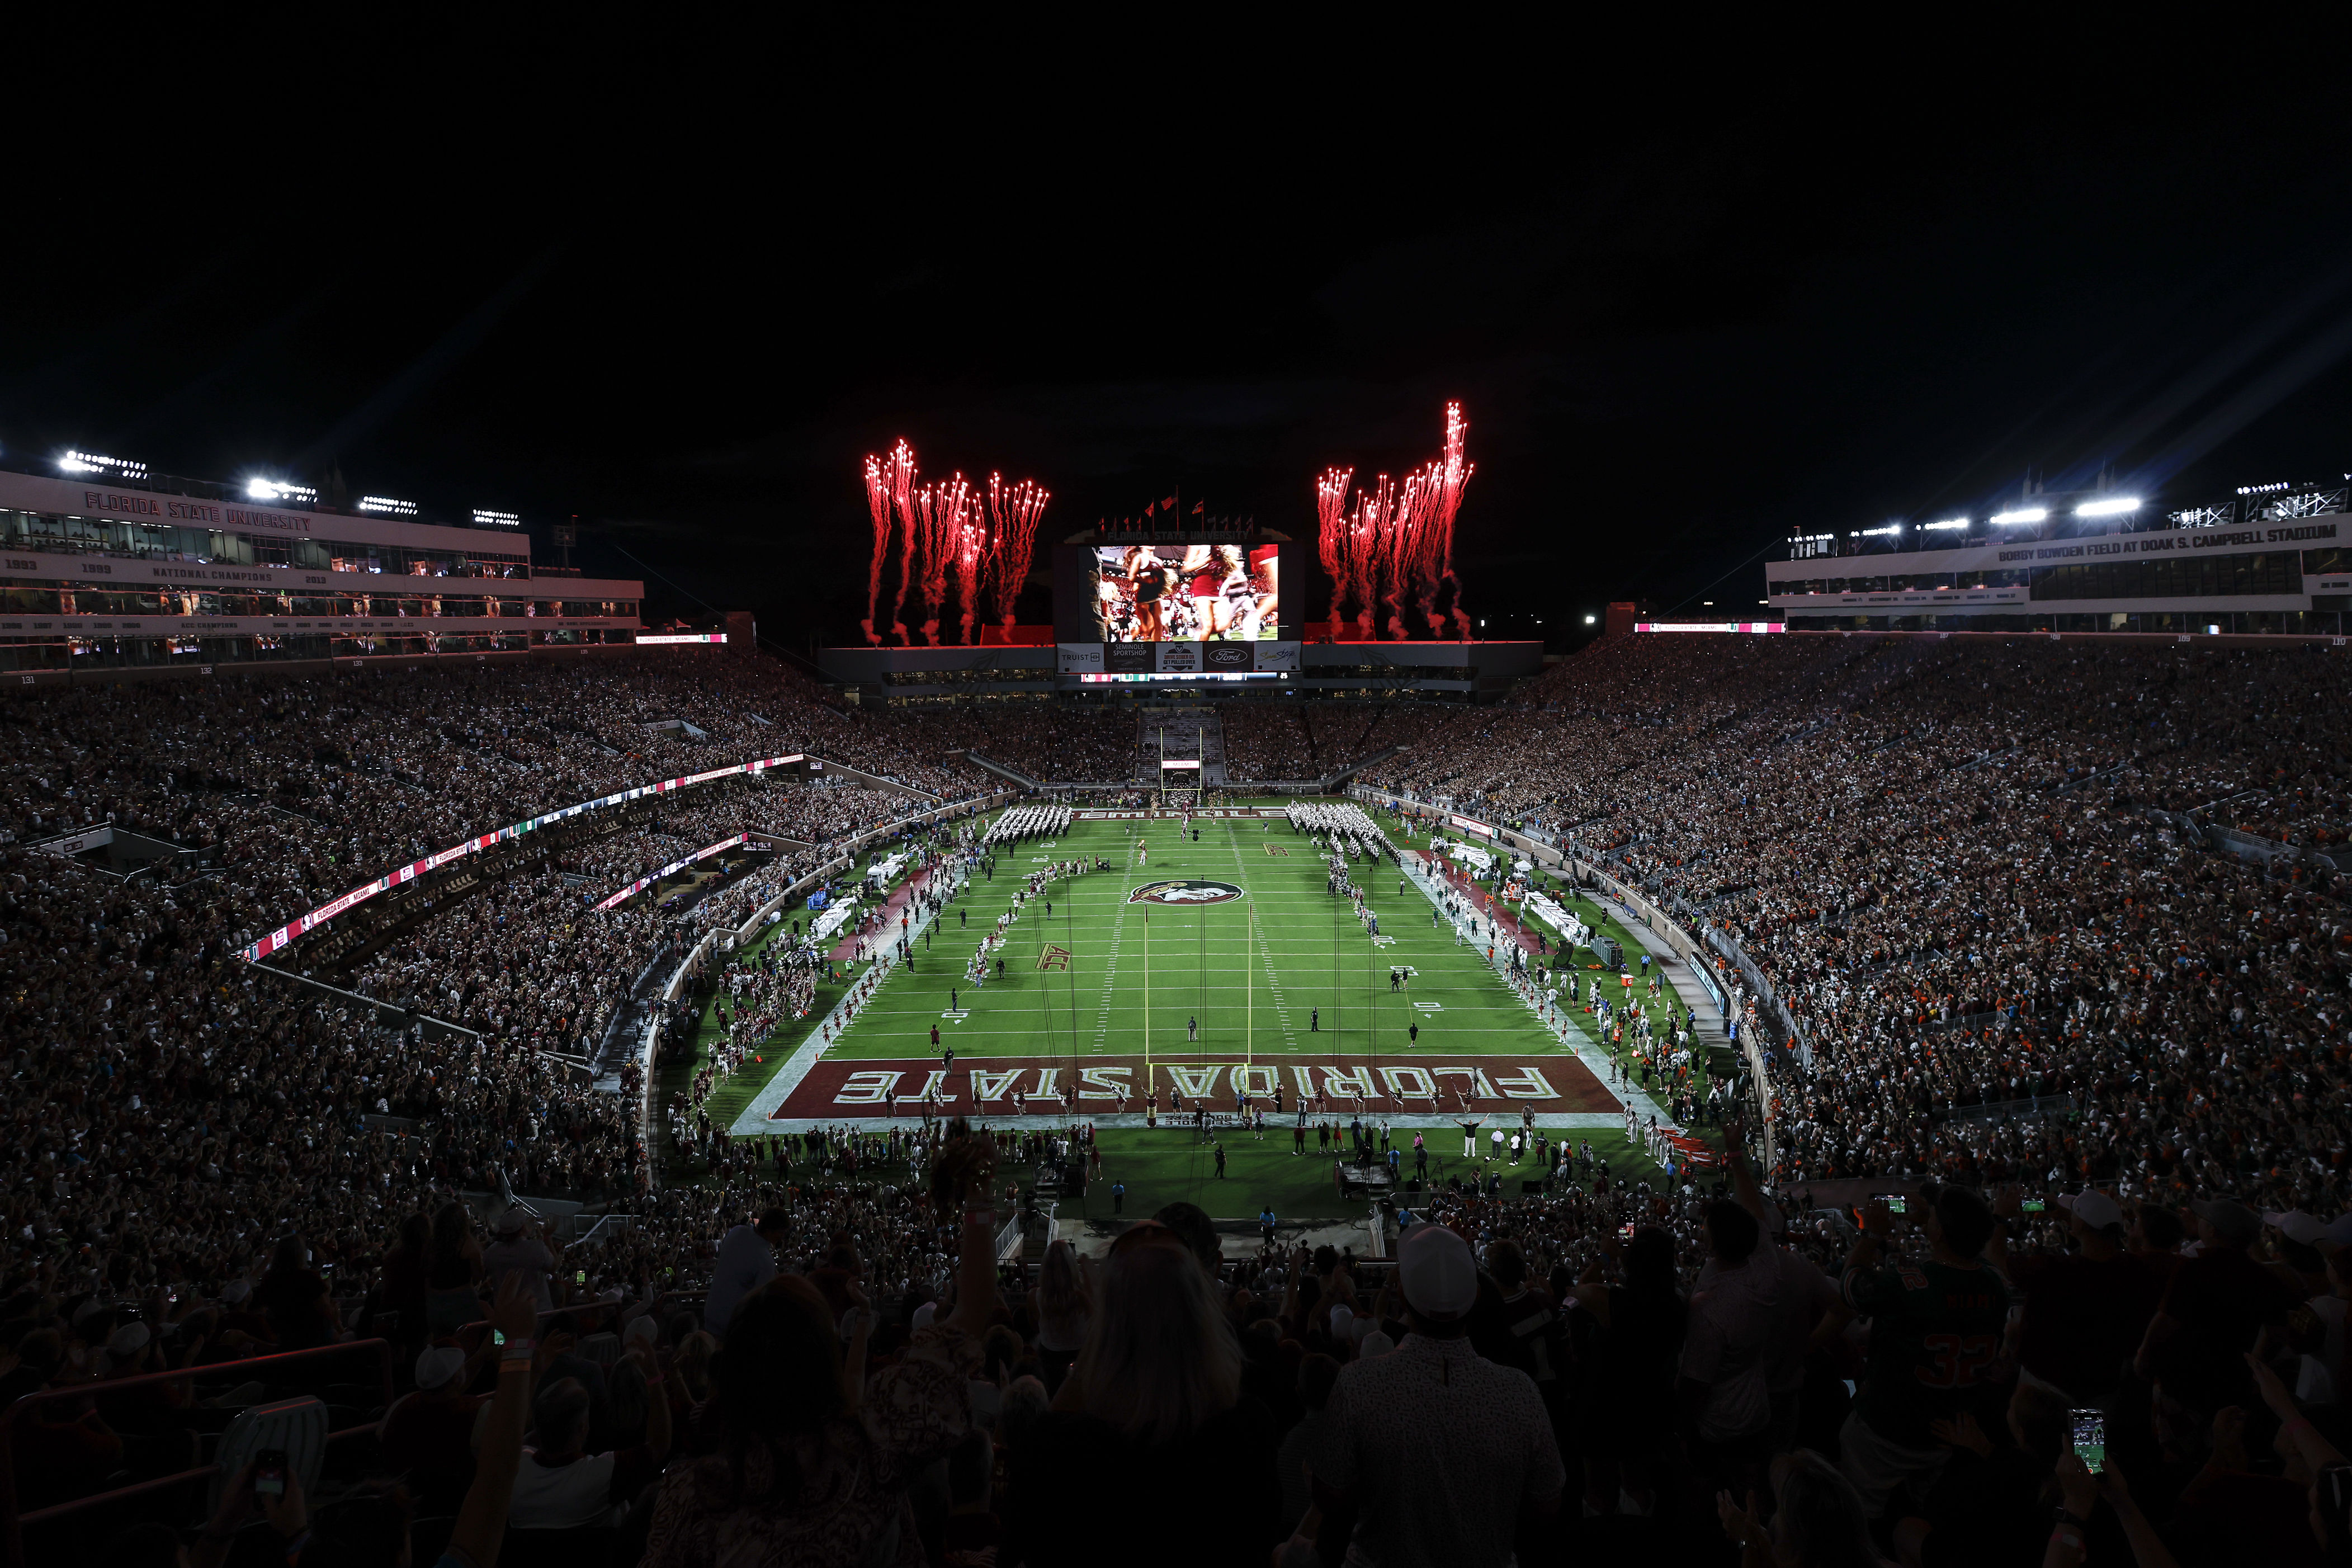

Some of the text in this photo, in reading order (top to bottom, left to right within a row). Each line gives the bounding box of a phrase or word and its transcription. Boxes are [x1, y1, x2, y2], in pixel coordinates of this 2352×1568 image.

[86, 492, 311, 531] FLORIDA STATE UNIVERSITY
[1107, 531, 1249, 541] FLORIDA STATE UNIVERSITY
[1999, 524, 2336, 561] BOBBY BOWDEN FIELD AT DOAK S. CAMPBELL STADIUM
[6, 559, 37, 570] 1993
[82, 564, 111, 574] 1999
[153, 568, 272, 582] NATIONAL CHAMPIONS
[2332, 638, 2346, 646] 110
[1216, 650, 1240, 661] Ford
[22, 676, 35, 684] 131
[574, 805, 583, 815] QTR
[544, 815, 554, 824] BALL
[527, 820, 532, 831] 0
[1470, 823, 1482, 832] MIAMI
[490, 833, 495, 843] 0
[709, 846, 717, 854] STATE
[440, 851, 456, 862] FLORIDA
[318, 888, 370, 920] FLORIDA STATE MIAMI
[611, 894, 622, 904] MIAMI
[1042, 945, 1071, 972] ACC
[1704, 973, 1714, 994] MIAMI
[832, 1065, 1562, 1104] FLORIDA STATE
[1945, 1293, 1996, 1309] MIAMI
[1914, 1334, 1999, 1390] 32
